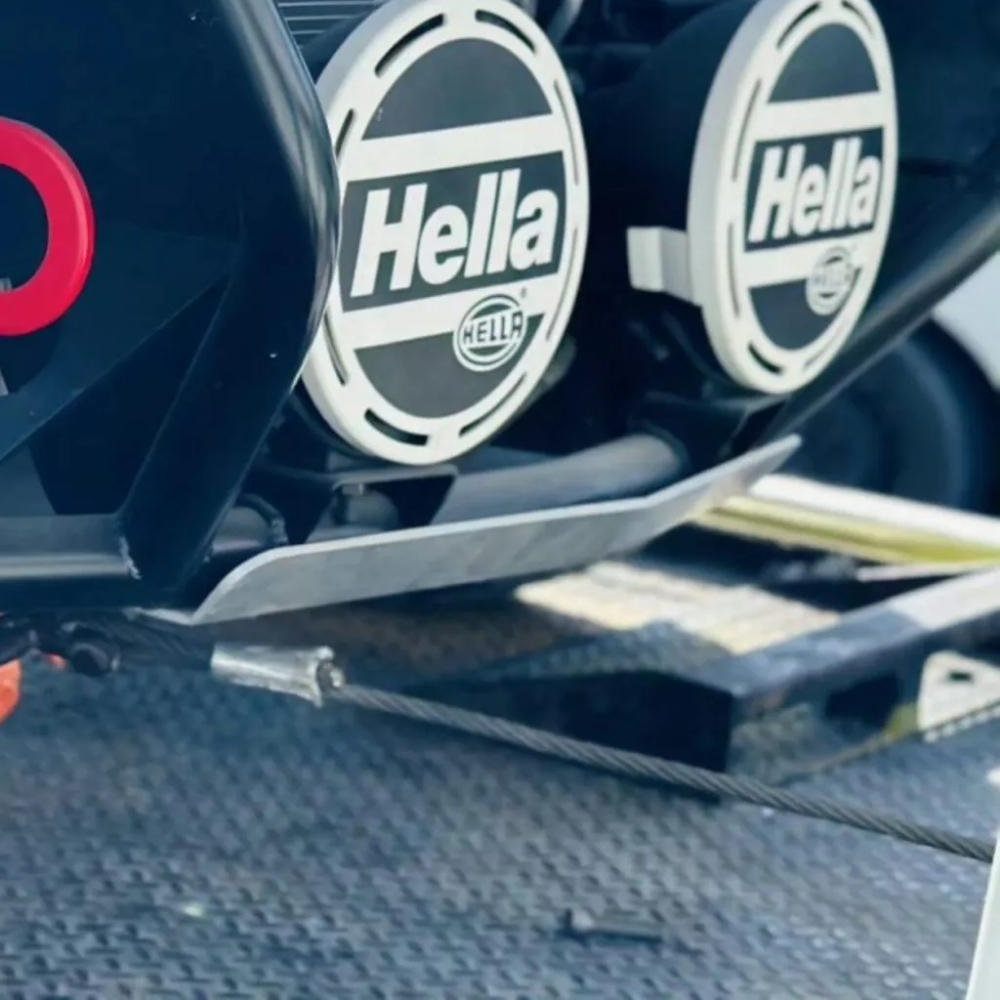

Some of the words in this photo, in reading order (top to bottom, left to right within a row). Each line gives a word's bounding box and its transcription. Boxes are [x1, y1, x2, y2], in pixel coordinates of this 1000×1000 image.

[350, 168, 559, 298] Hella
[748, 137, 881, 242] Hella
[462, 310, 524, 345] HELLA
